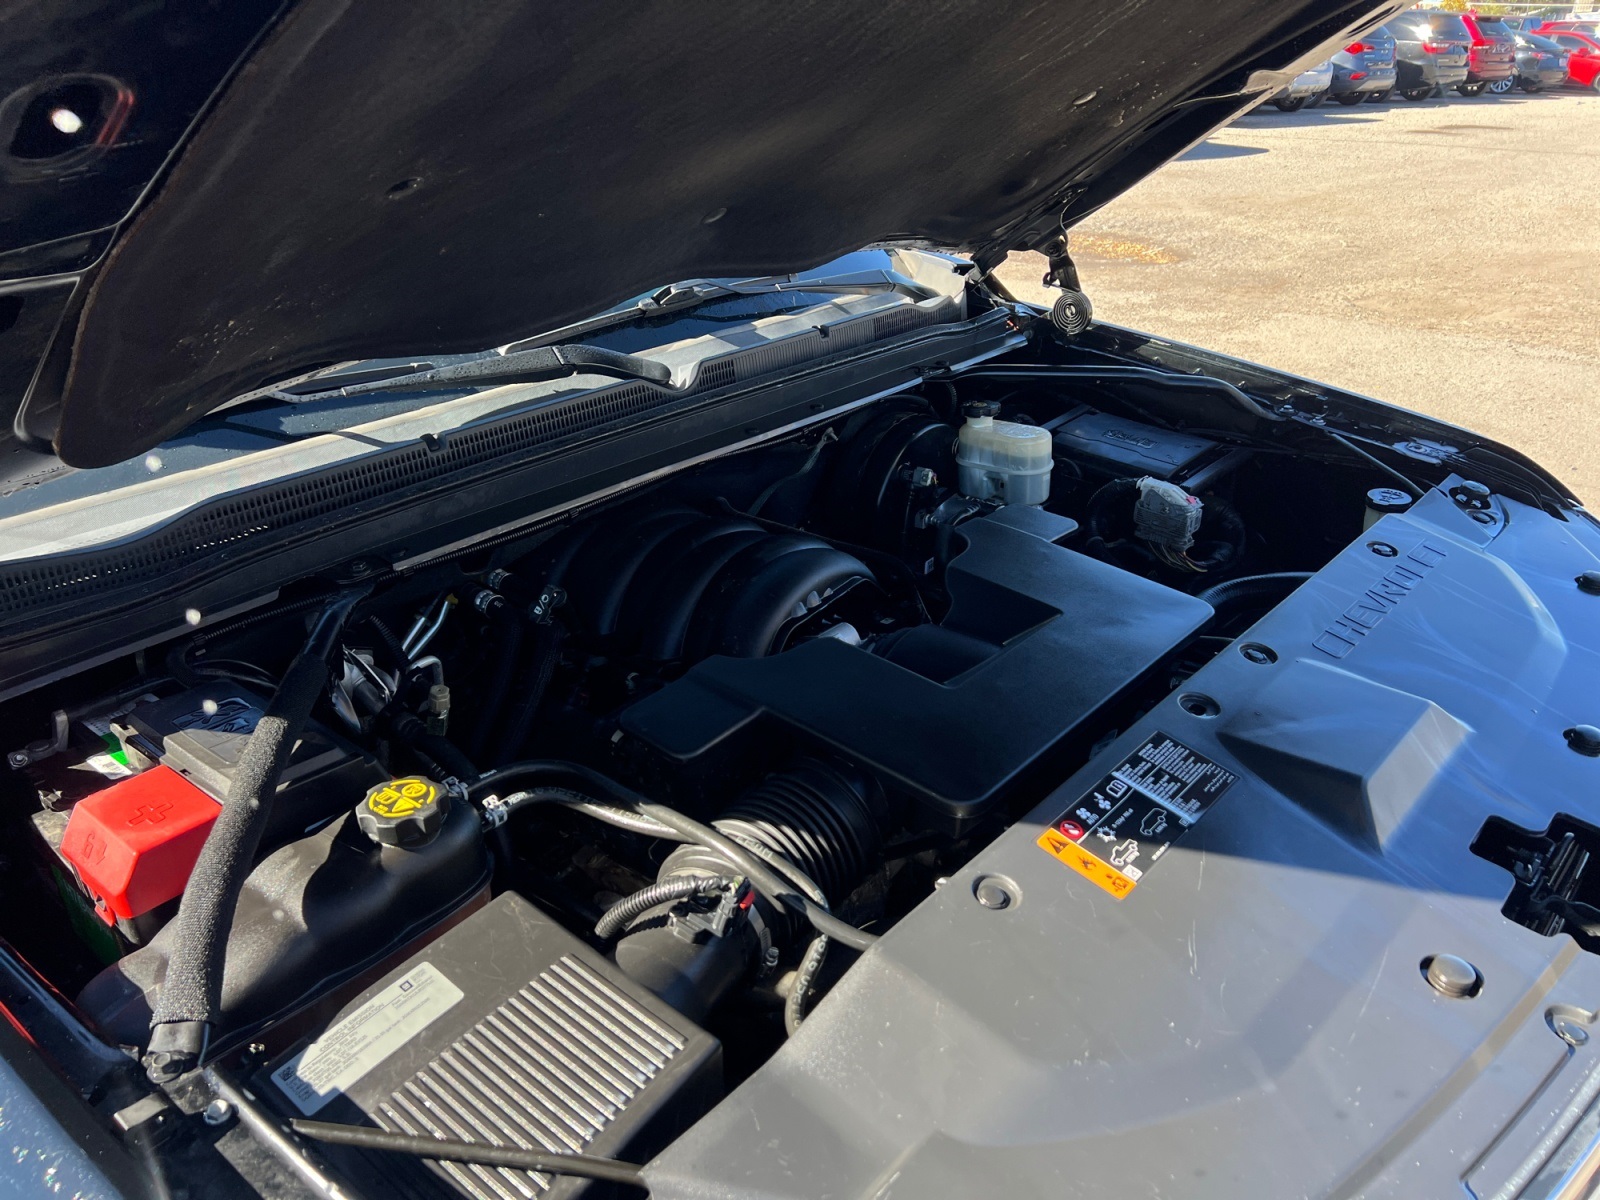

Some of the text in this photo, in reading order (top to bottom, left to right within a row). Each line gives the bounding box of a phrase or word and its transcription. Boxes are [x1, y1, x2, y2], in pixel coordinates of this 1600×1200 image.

[1312, 538, 1447, 659] CHEVROLET
[319, 1030, 348, 1053] CONTROL
[347, 1002, 385, 1032] INFORMATION
[323, 1024, 349, 1043] VEHICLE
[348, 1003, 376, 1025] EMISSION
